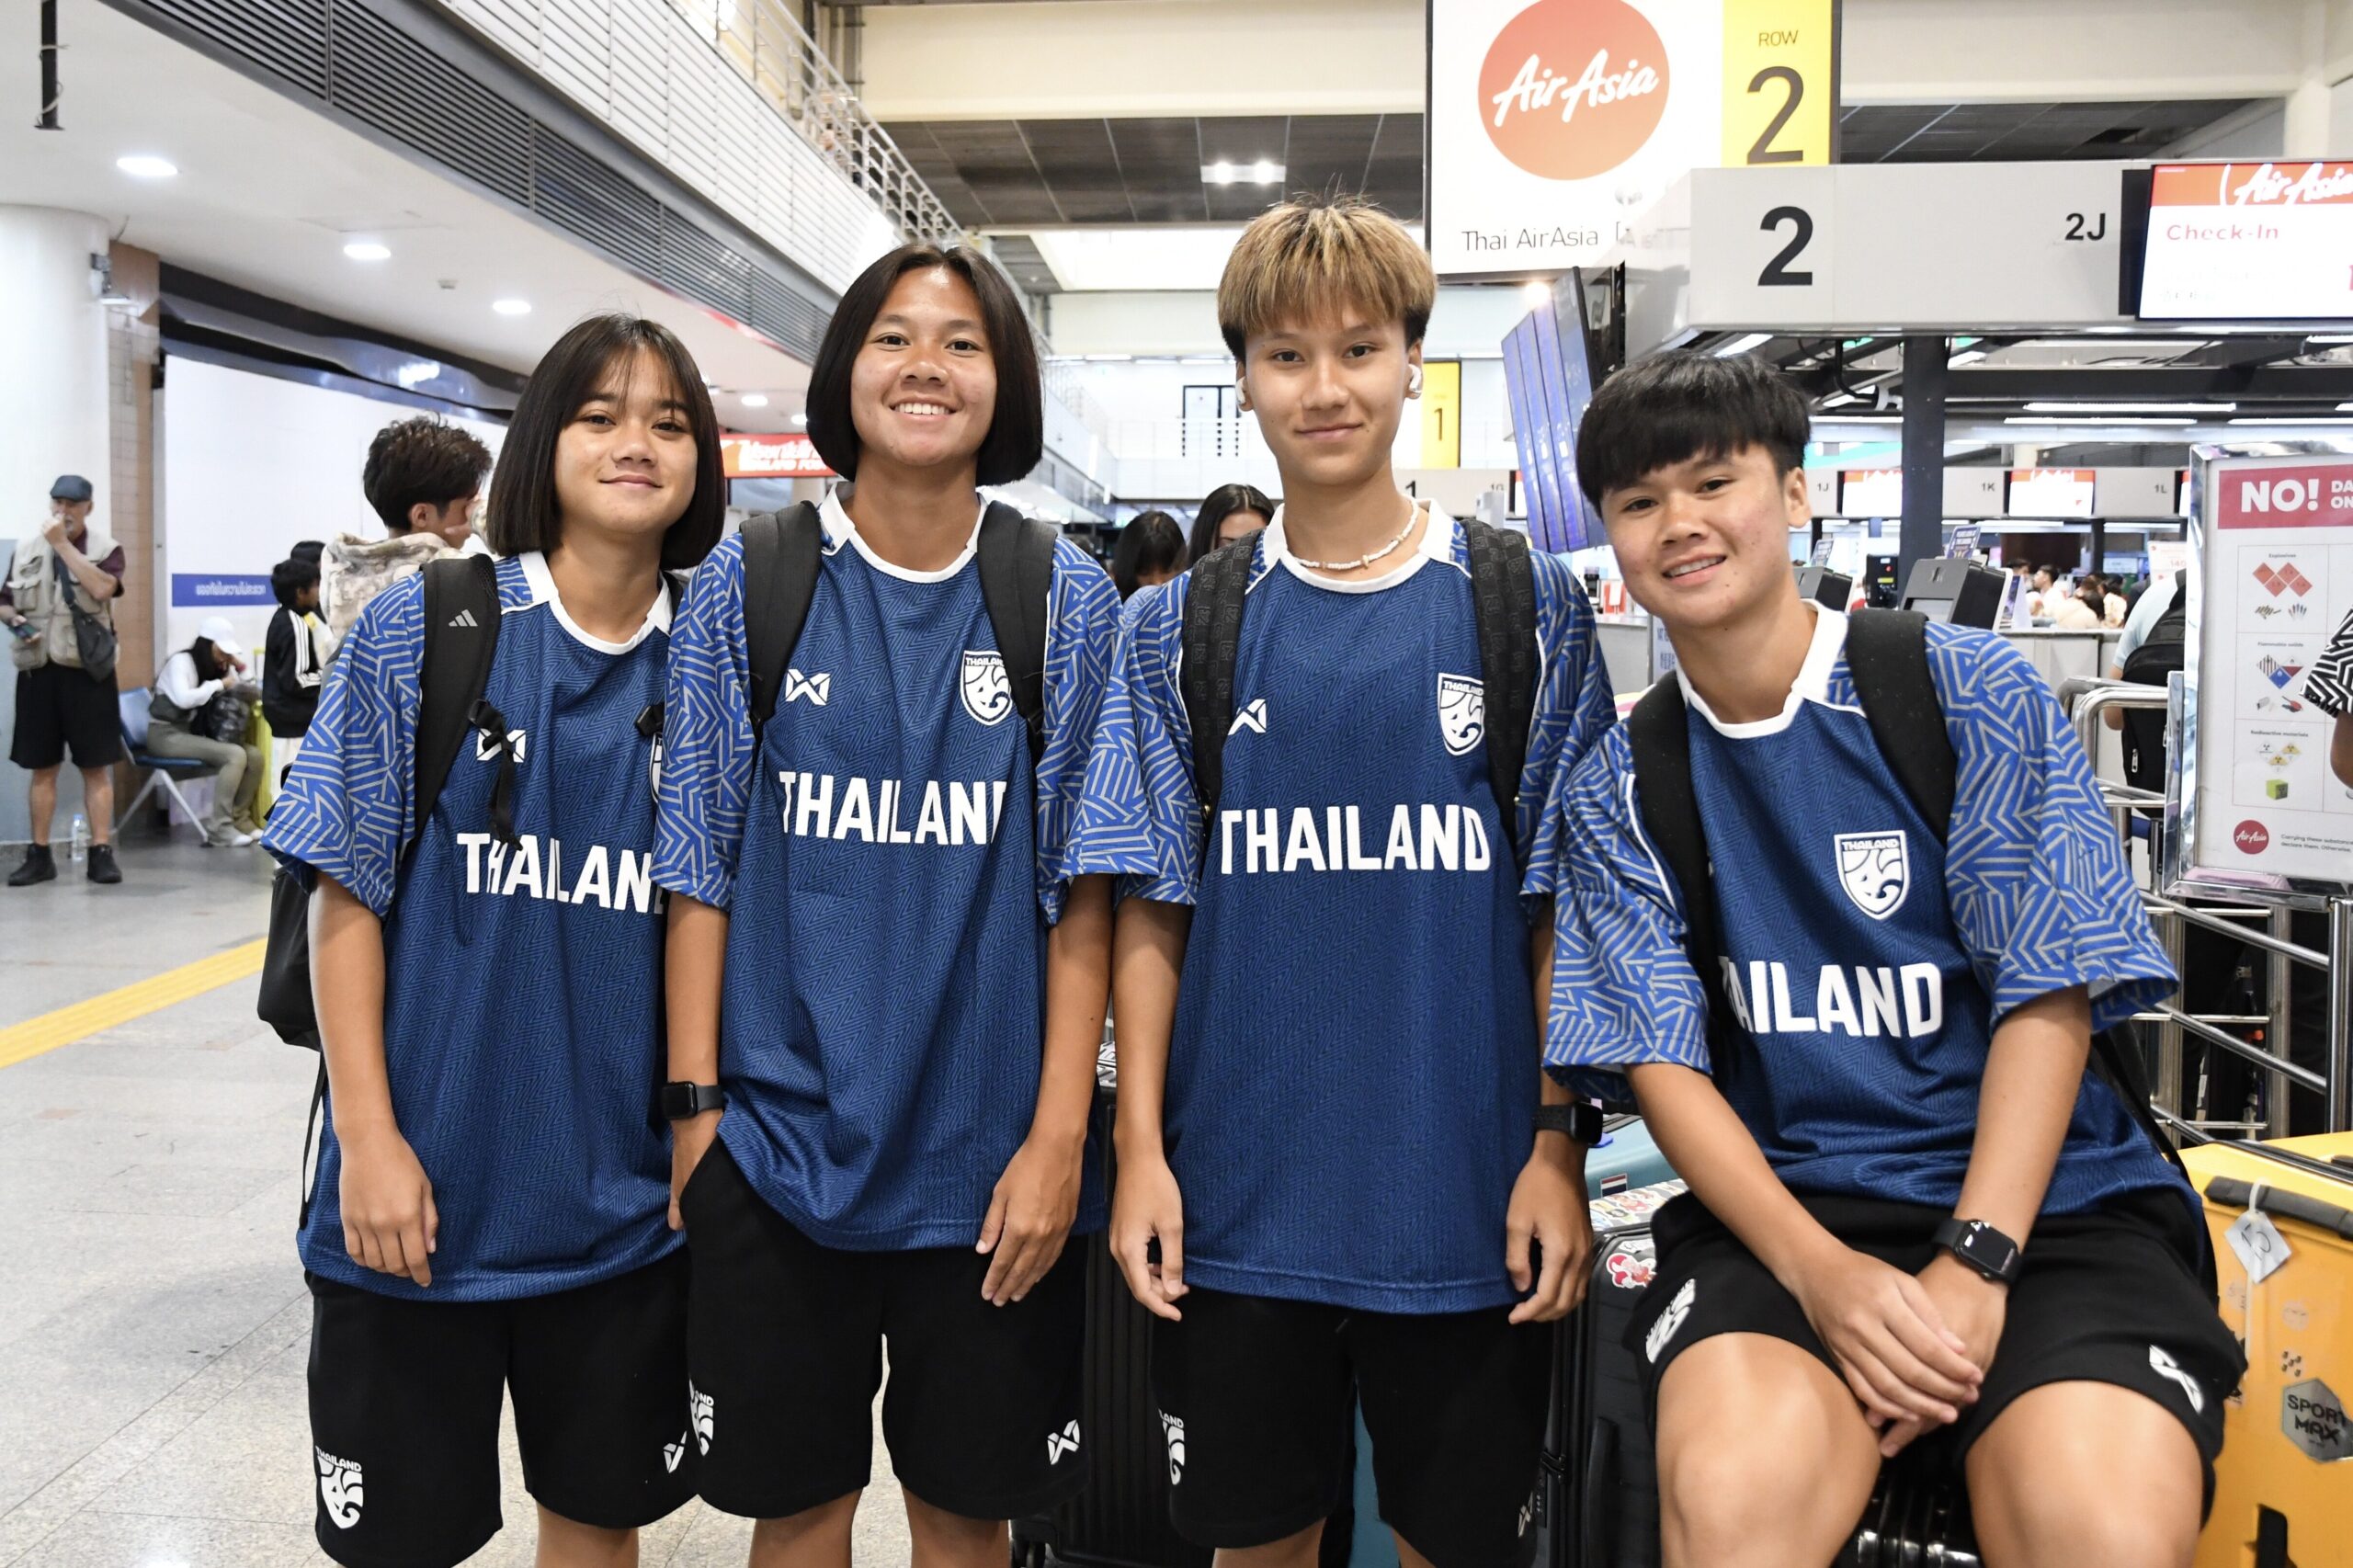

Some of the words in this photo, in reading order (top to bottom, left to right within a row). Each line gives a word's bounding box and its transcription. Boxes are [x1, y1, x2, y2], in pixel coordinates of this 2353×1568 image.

[1758, 29, 1798, 47] ROW
[1747, 65, 1804, 165] 2
[1461, 229, 1507, 251] Thai
[1517, 226, 1598, 249] AirAsia
[2065, 213, 2106, 241] 2J
[2166, 224, 2279, 241] Check-In
[1757, 206, 1813, 286] 2
[1434, 407, 1443, 441] 1
[1817, 483, 1829, 492] 1J
[1982, 483, 1995, 492] 1K
[2154, 484, 2167, 494] 1L
[2241, 478, 2319, 513] NO!
[966, 657, 1005, 667] THAILAN
[1221, 804, 1491, 874] THAILAND
[1841, 837, 1900, 851] THAILAND
[1719, 956, 1942, 1039] AILAND
[2294, 1415, 2340, 1446] MAX
[315, 1445, 362, 1472] THAILAND
